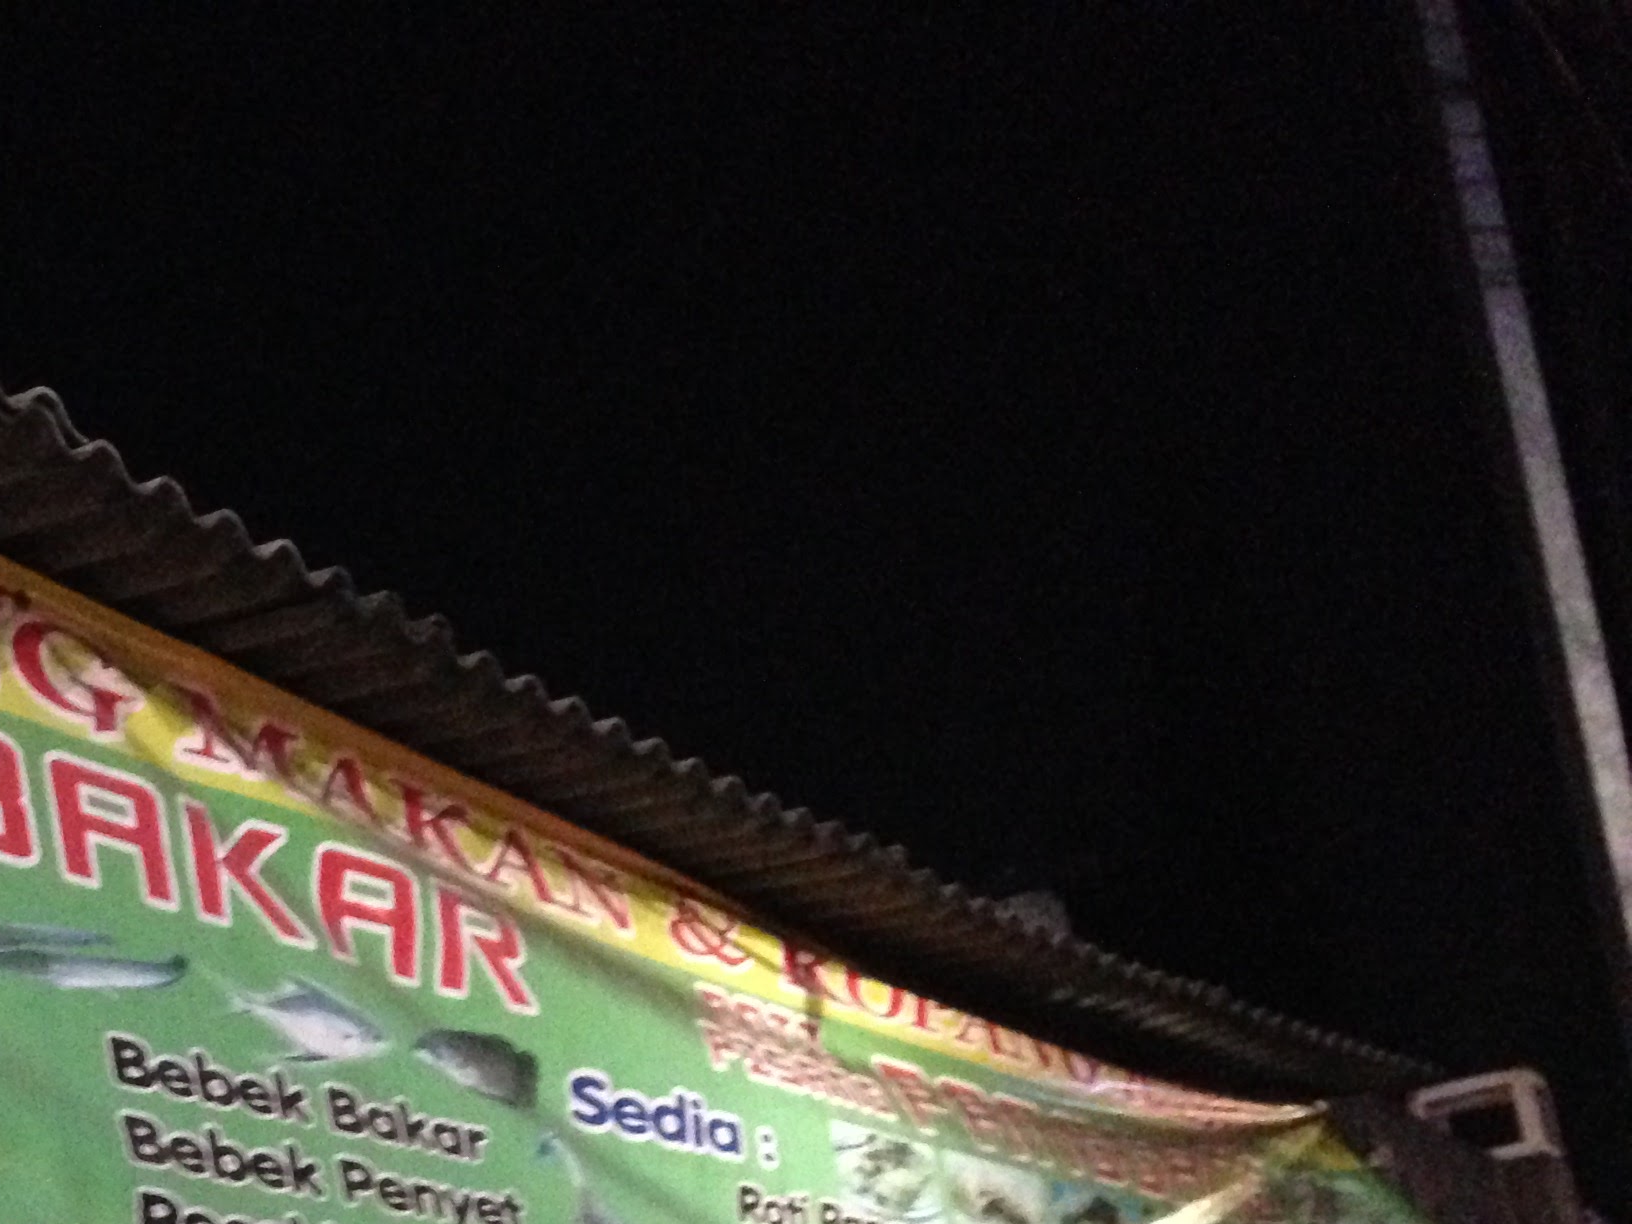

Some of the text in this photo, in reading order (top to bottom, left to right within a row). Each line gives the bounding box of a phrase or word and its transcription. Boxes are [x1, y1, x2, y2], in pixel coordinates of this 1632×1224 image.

[168, 682, 634, 934] MAKAN
[109, 1036, 489, 1160] Bebek Bakar
[569, 1075, 743, 1155] Sedia
[125, 1115, 322, 1198] Bebek
